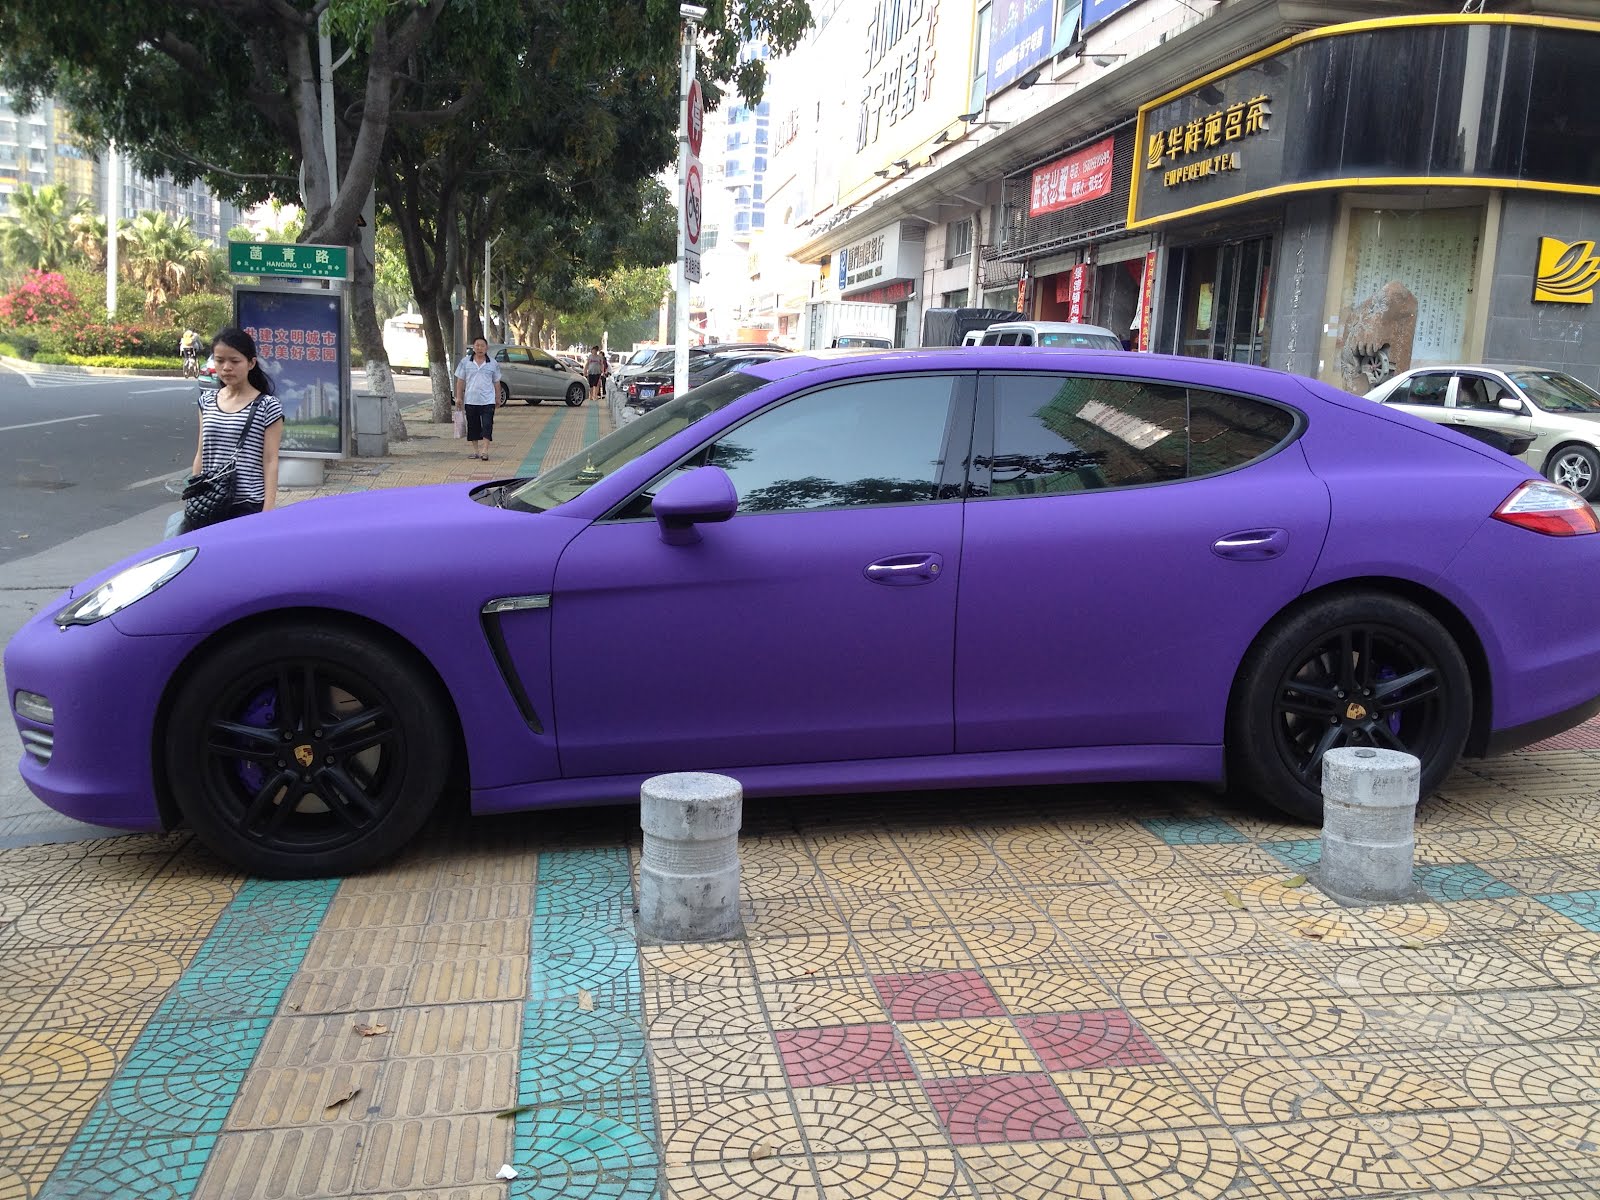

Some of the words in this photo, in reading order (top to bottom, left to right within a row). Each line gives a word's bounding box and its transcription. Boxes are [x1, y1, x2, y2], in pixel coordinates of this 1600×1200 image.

[1166, 94, 1272, 161] 华祥苑茗茶
[1214, 152, 1241, 171] TEA
[249, 245, 330, 264] 菡青路
[266, 261, 297, 269] HANQING
[244, 326, 337, 346] 共建文明城市
[256, 344, 336, 362] 享美好家园
